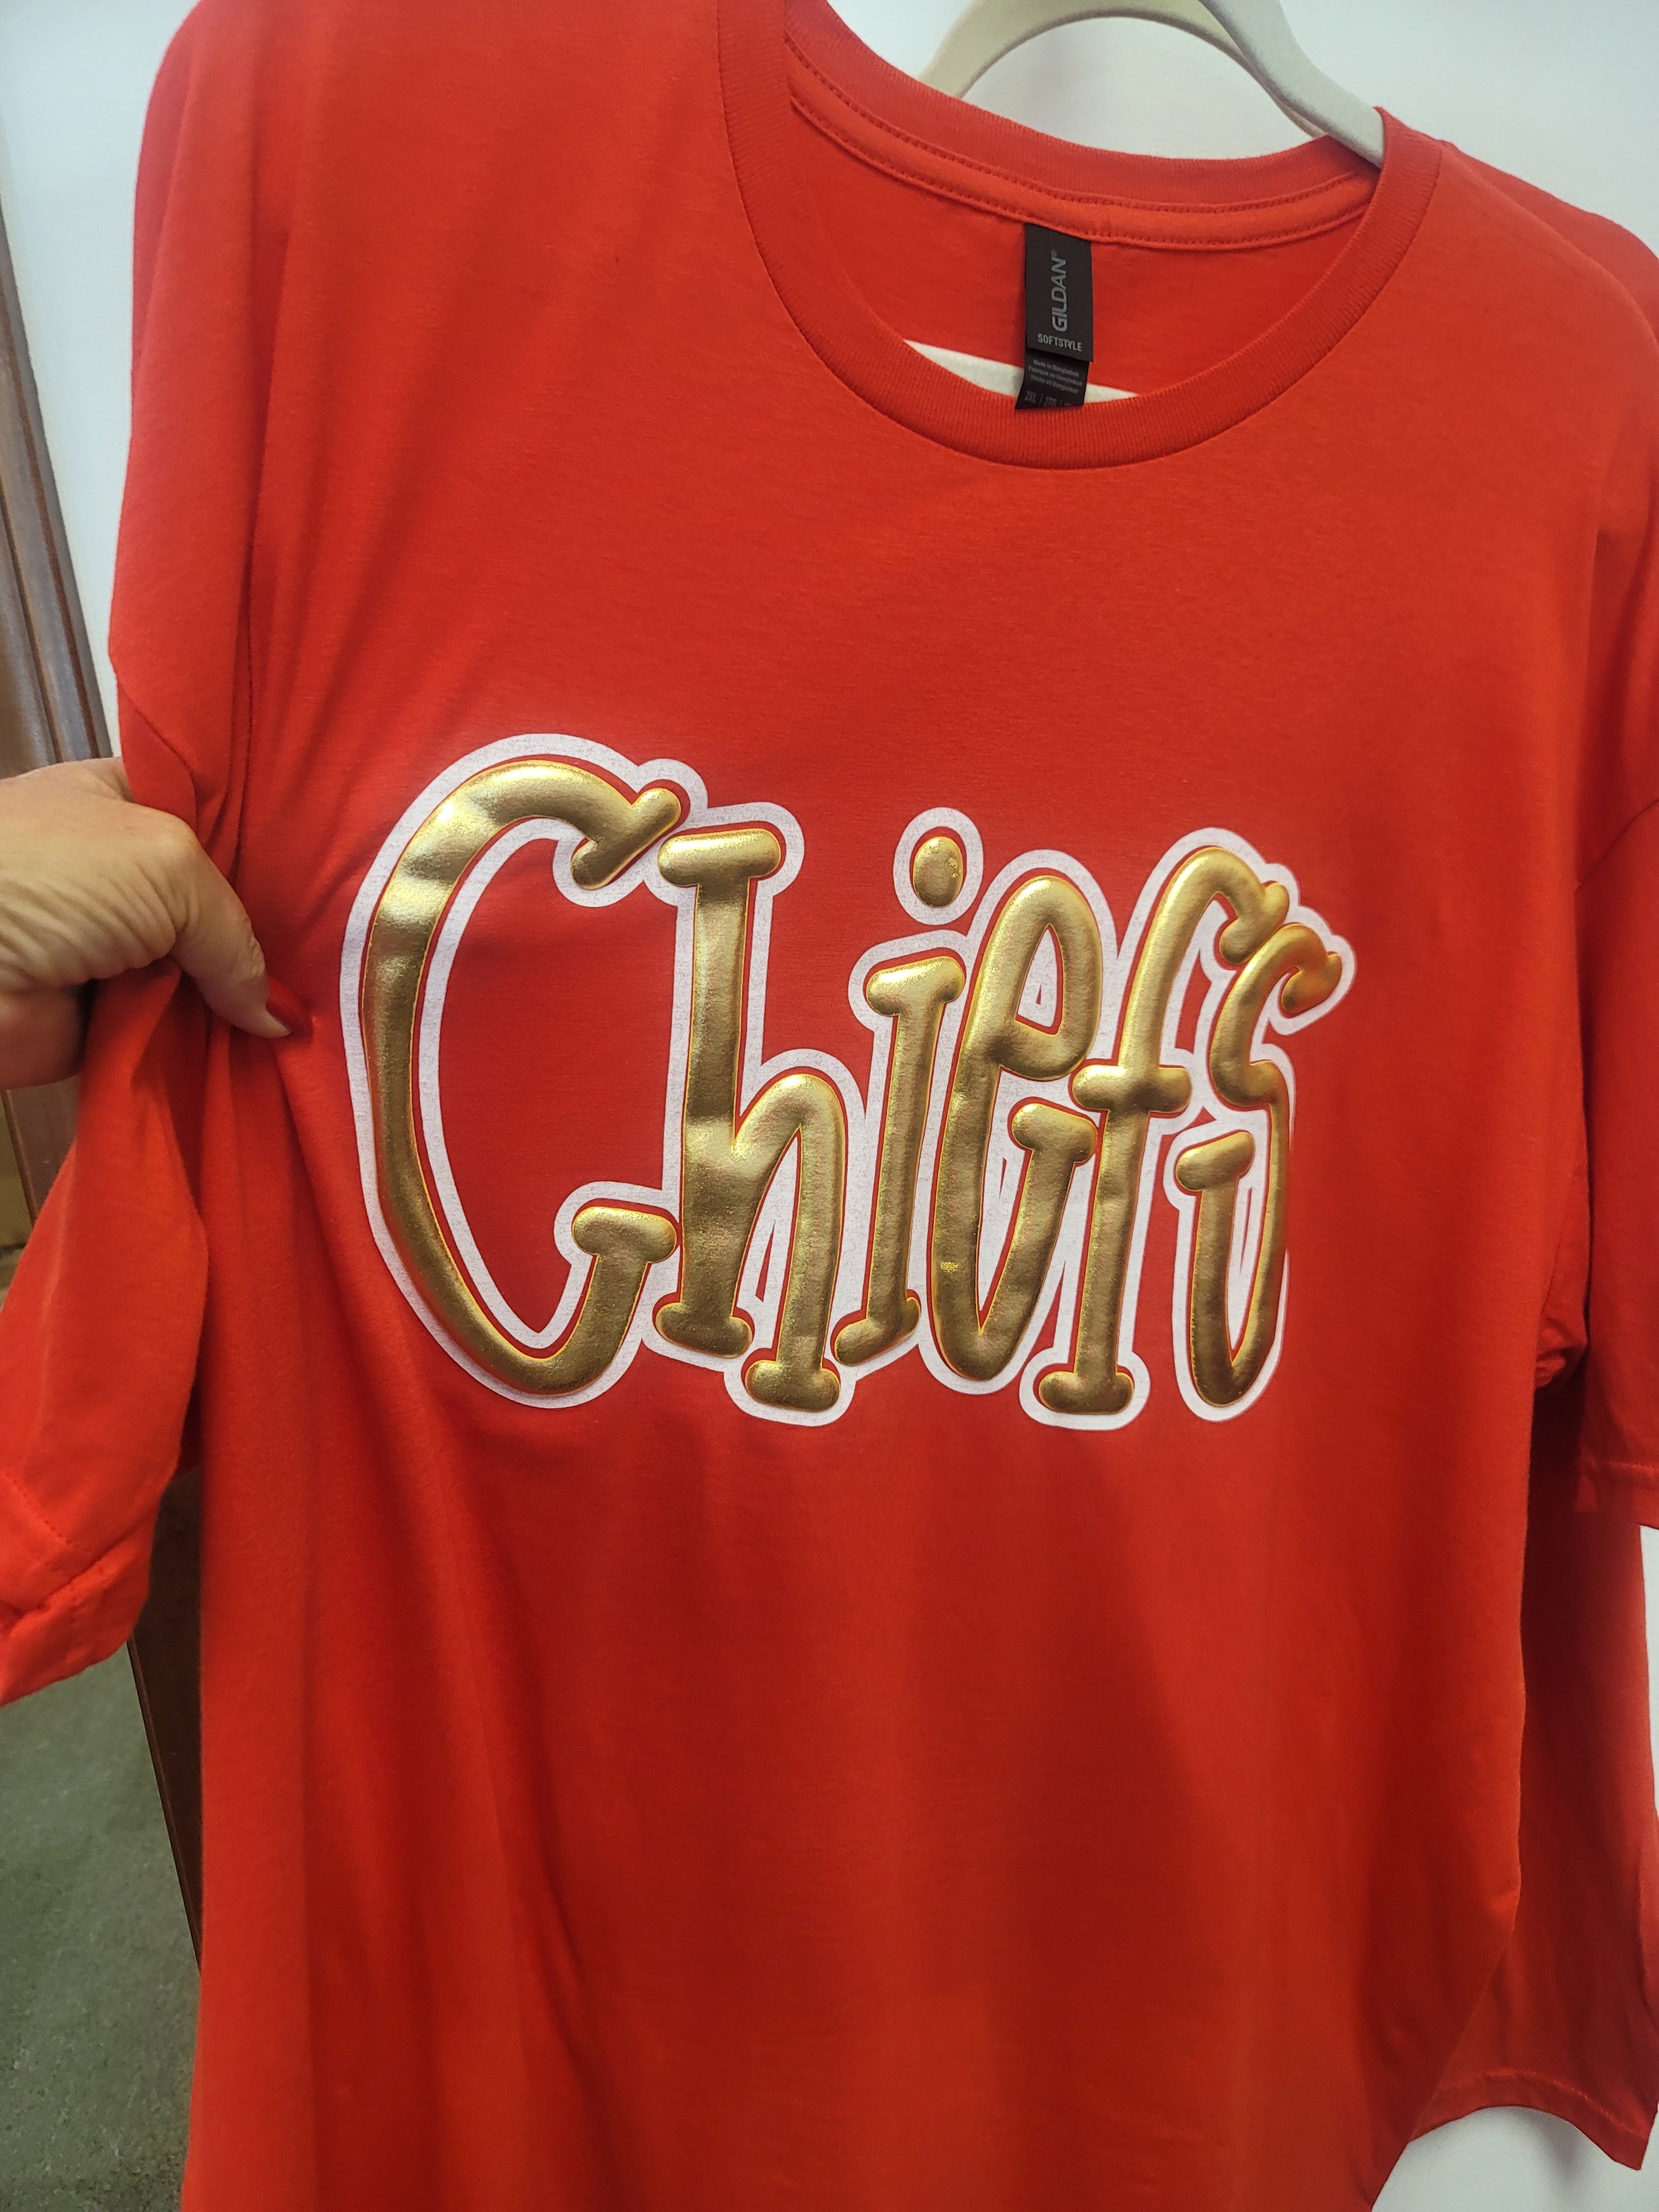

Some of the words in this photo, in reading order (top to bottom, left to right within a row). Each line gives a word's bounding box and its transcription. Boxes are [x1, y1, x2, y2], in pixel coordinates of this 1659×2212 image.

[1051, 256, 1067, 332] GILDAN
[1037, 333, 1082, 352] SOFTSTYLE
[341, 733, 1355, 1429] Chiefs
